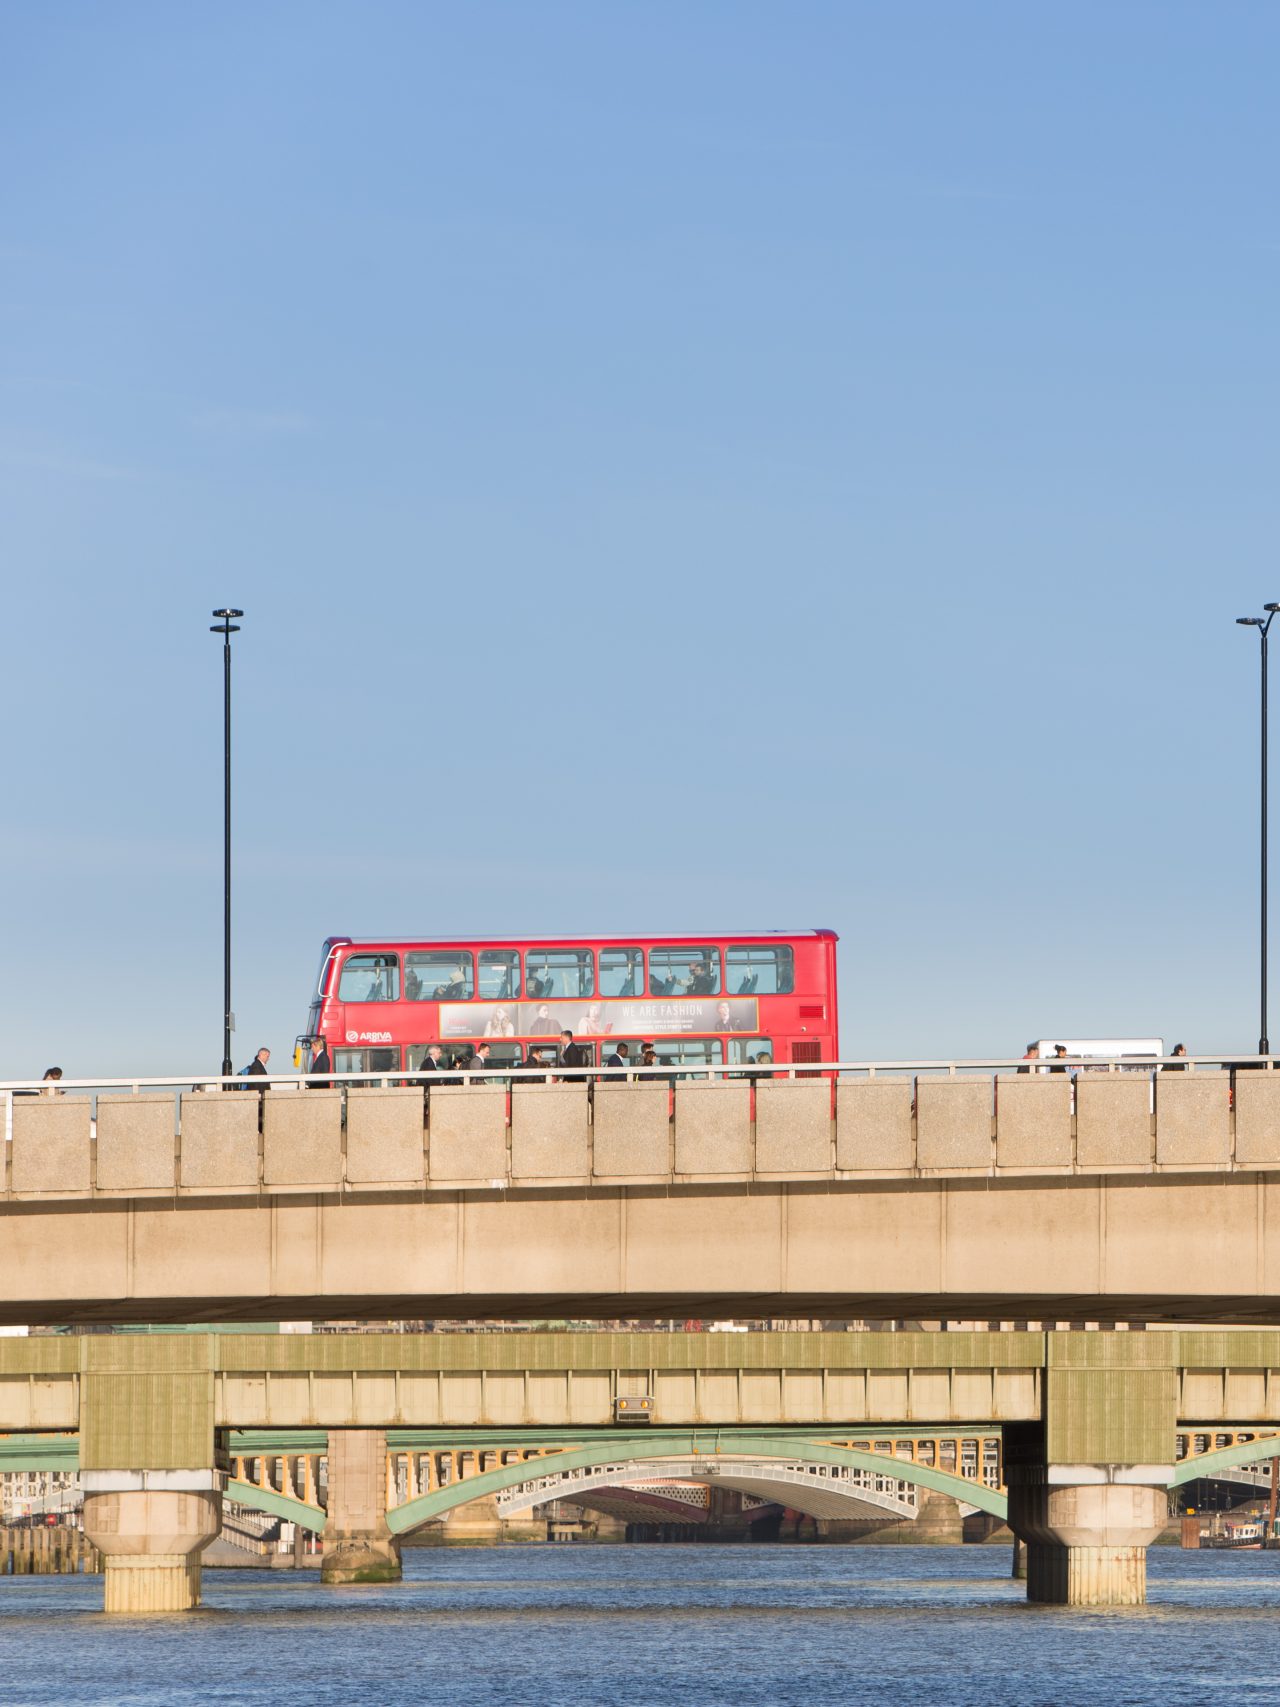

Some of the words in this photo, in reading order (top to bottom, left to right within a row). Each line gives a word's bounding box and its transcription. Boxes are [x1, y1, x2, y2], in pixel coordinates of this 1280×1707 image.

[623, 1006, 635, 1017] WE
[639, 1005, 657, 1017] ARE
[660, 1004, 703, 1016] FASHION
[360, 1031, 392, 1040] ARRIVA
